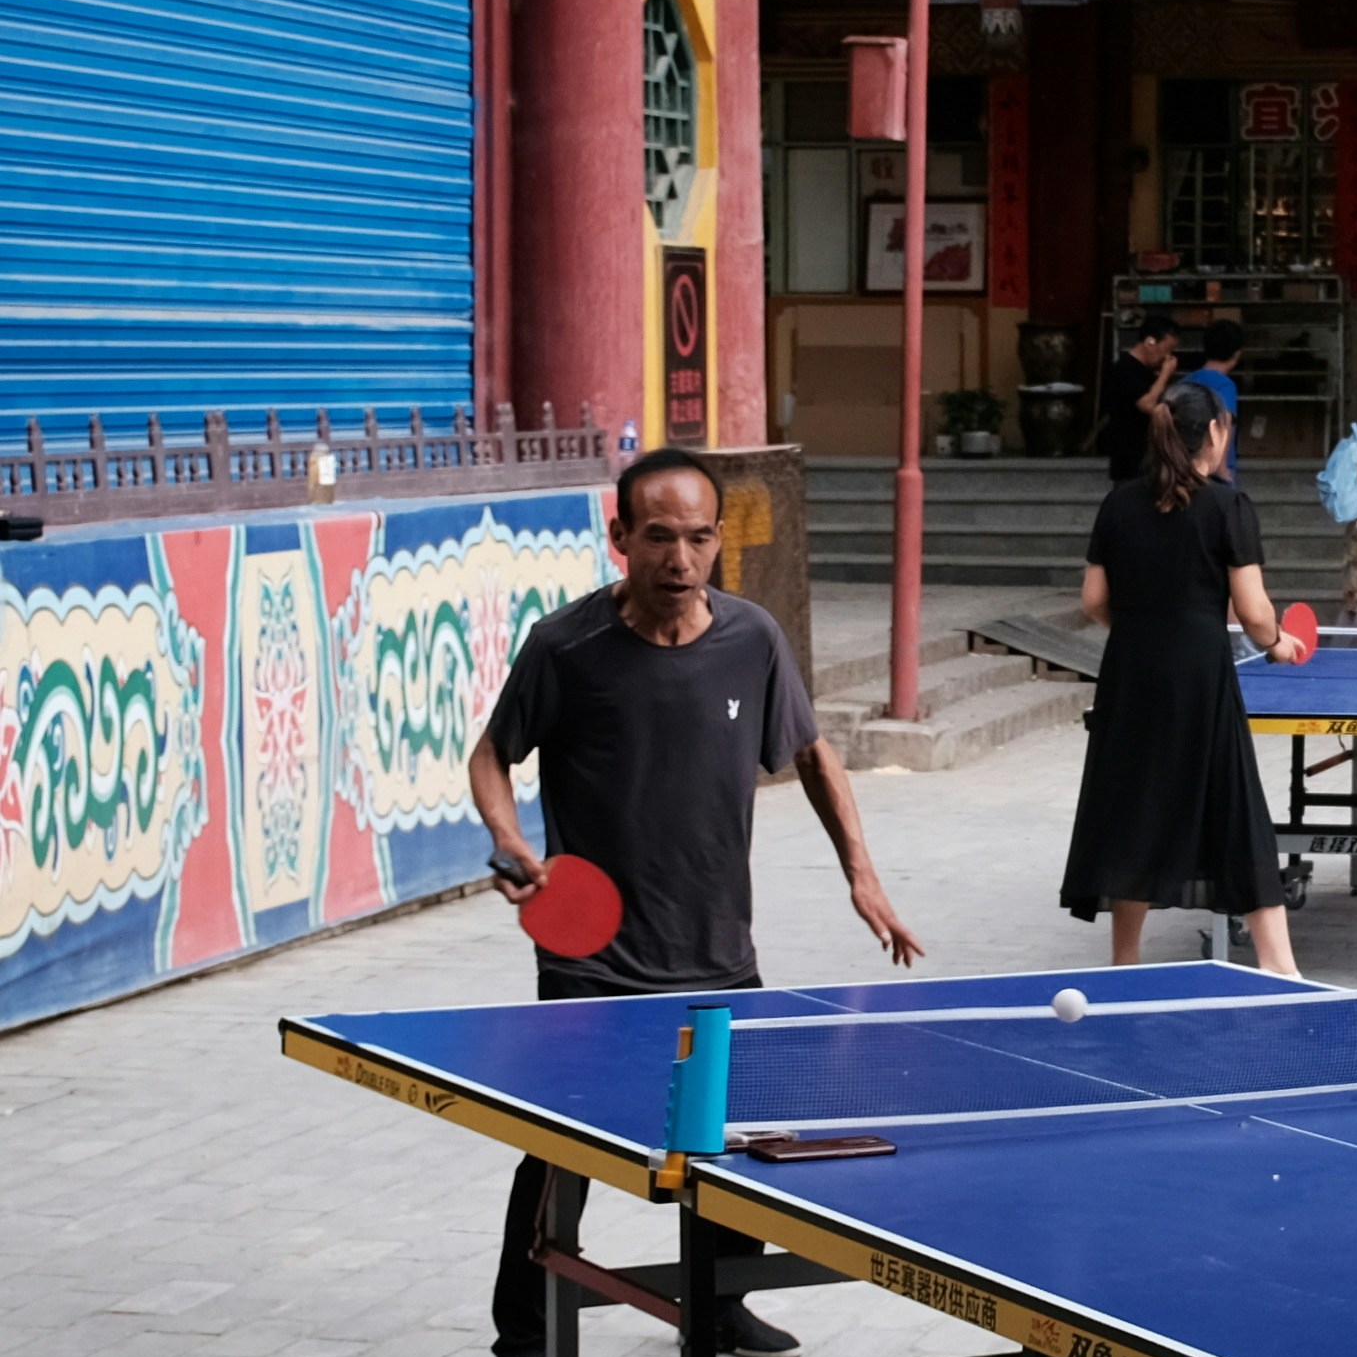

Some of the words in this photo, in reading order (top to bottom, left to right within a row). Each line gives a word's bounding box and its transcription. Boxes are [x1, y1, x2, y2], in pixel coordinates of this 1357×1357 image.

[871, 1252, 998, 1332] 世乒赛器材供应商
